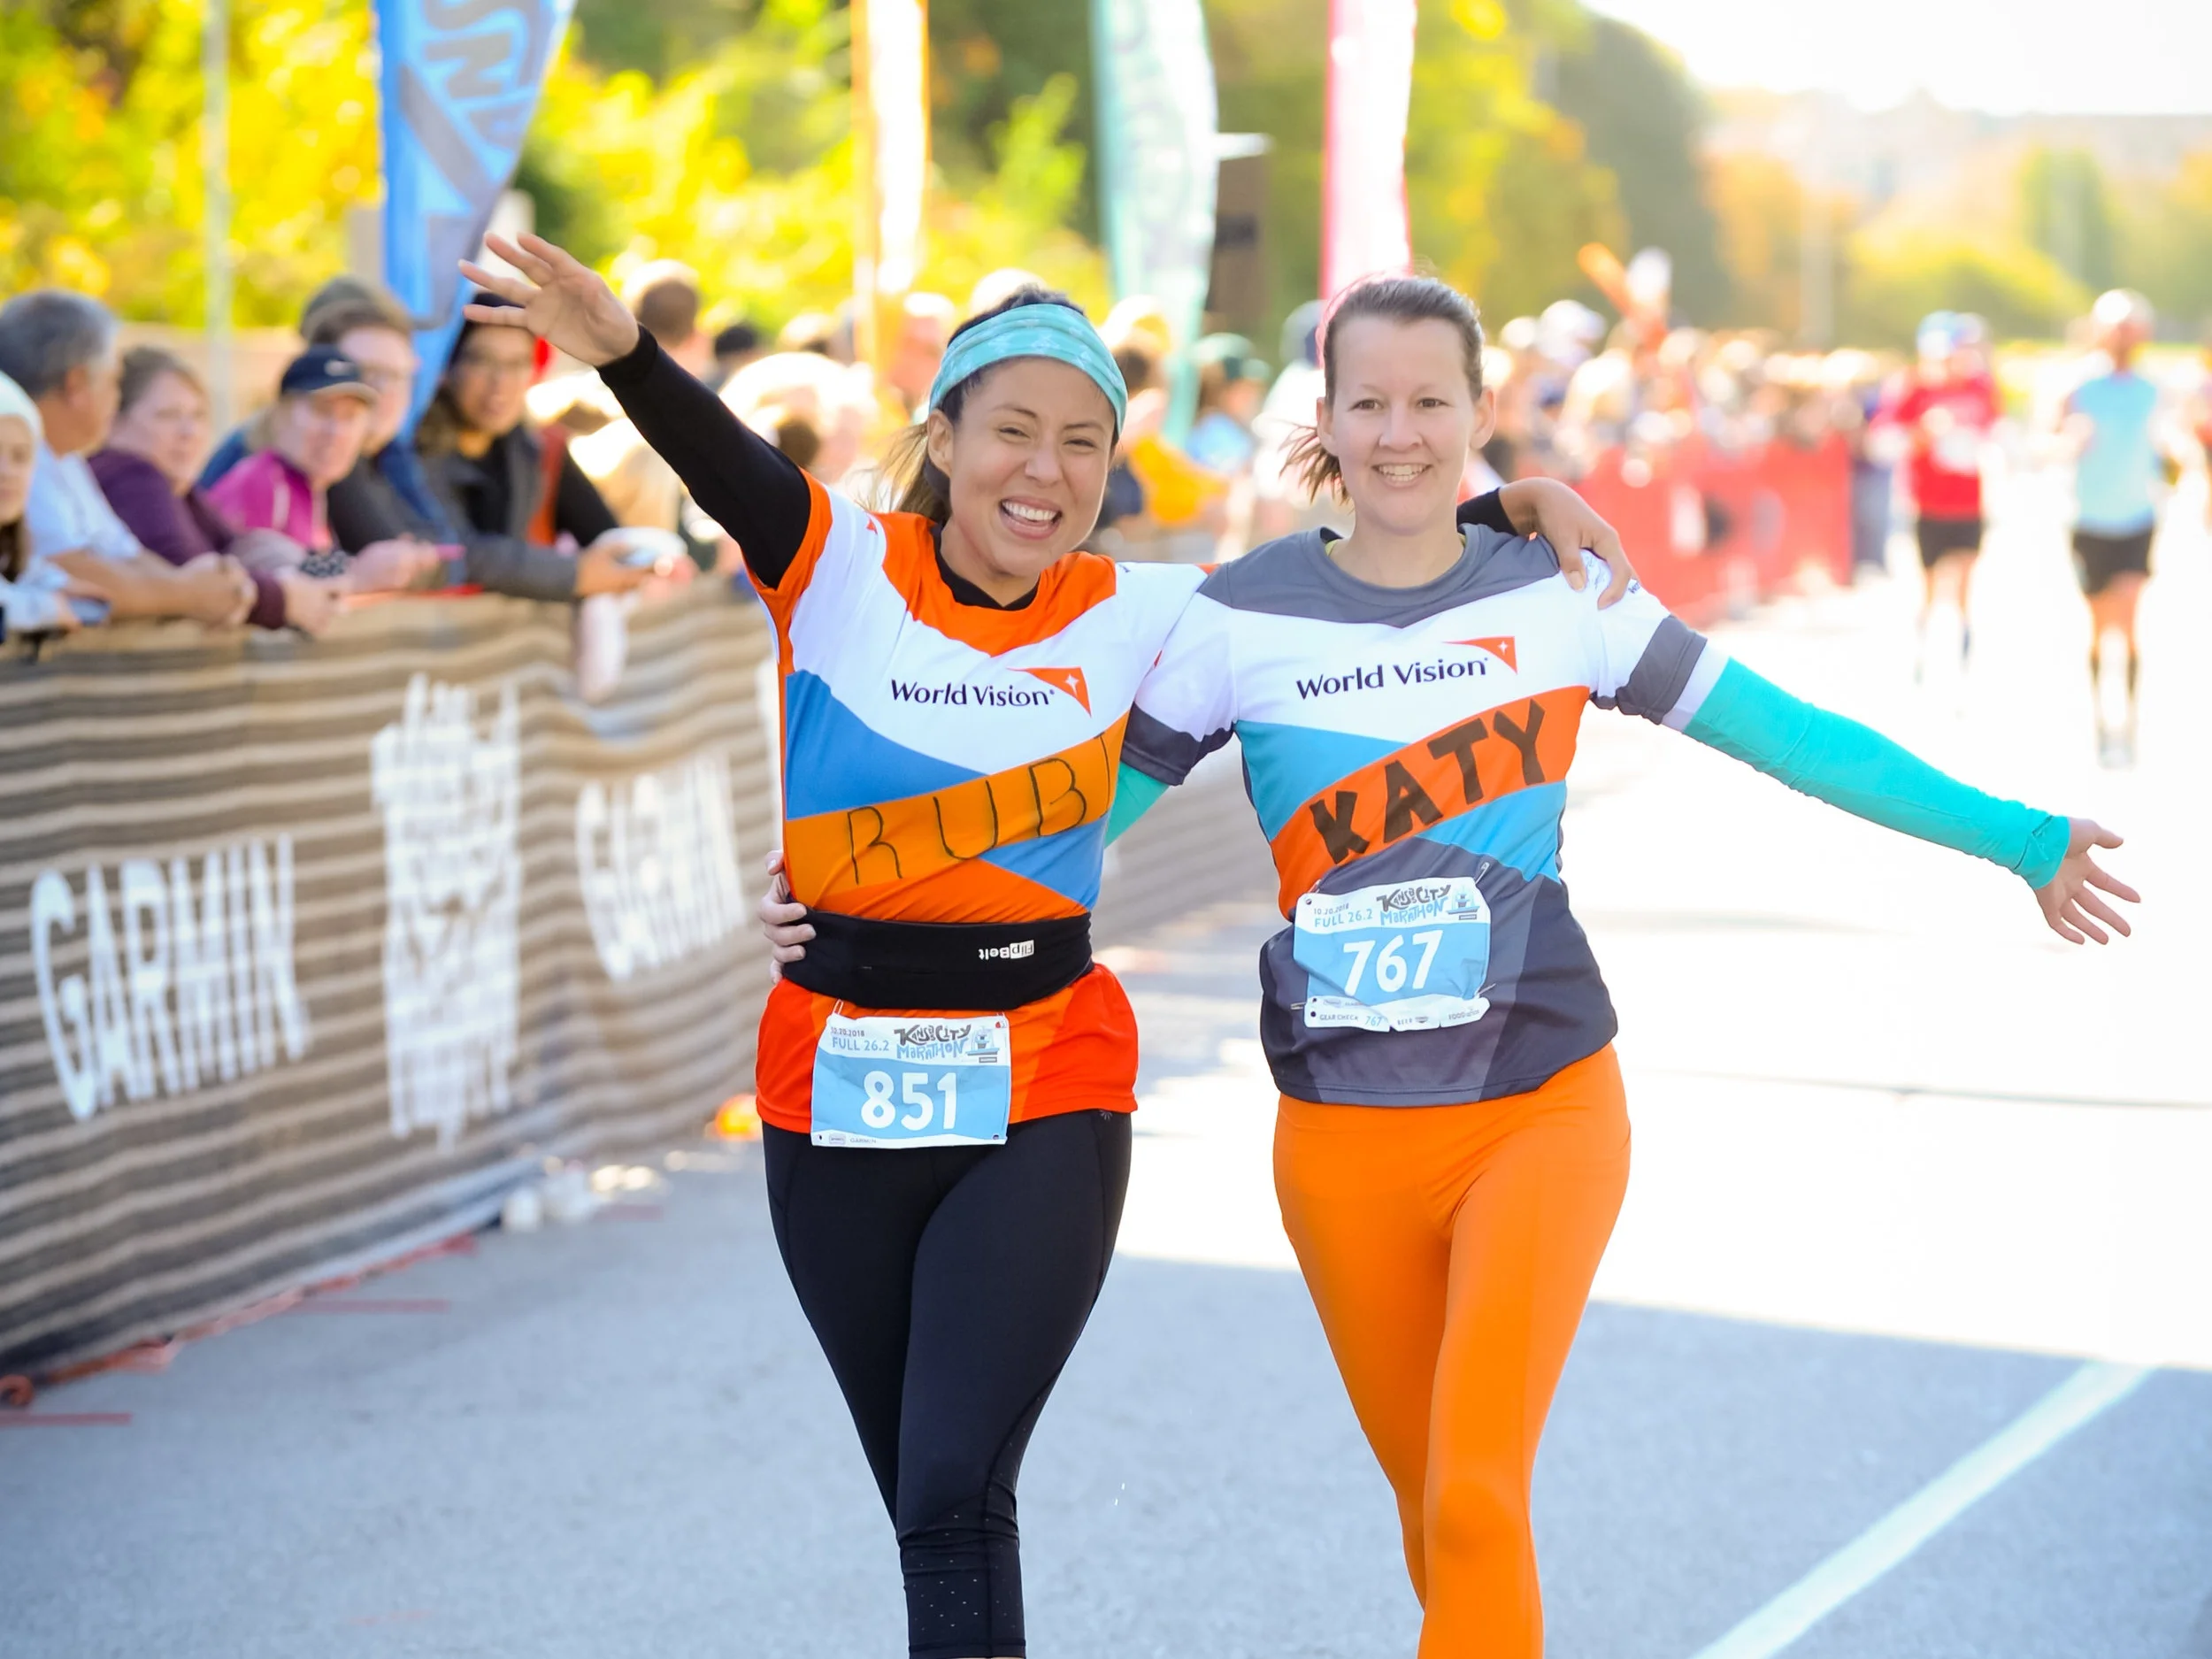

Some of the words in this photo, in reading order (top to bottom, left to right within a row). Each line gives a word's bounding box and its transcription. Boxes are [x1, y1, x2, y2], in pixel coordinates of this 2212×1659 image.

[891, 679, 967, 705] World
[972, 684, 1050, 707] Vision
[1296, 664, 1384, 700] World
[1393, 659, 1486, 685] Vision
[1309, 698, 1547, 864] KATY
[1315, 913, 1345, 927] FULL
[1348, 908, 1373, 923] 26.2
[30, 833, 310, 1122] GARMIN
[1343, 930, 1443, 997] 767
[1364, 1015, 1383, 1027] 767
[832, 1037, 861, 1051] FULL
[864, 1040, 889, 1051] 26.2
[861, 1071, 956, 1131] 851
